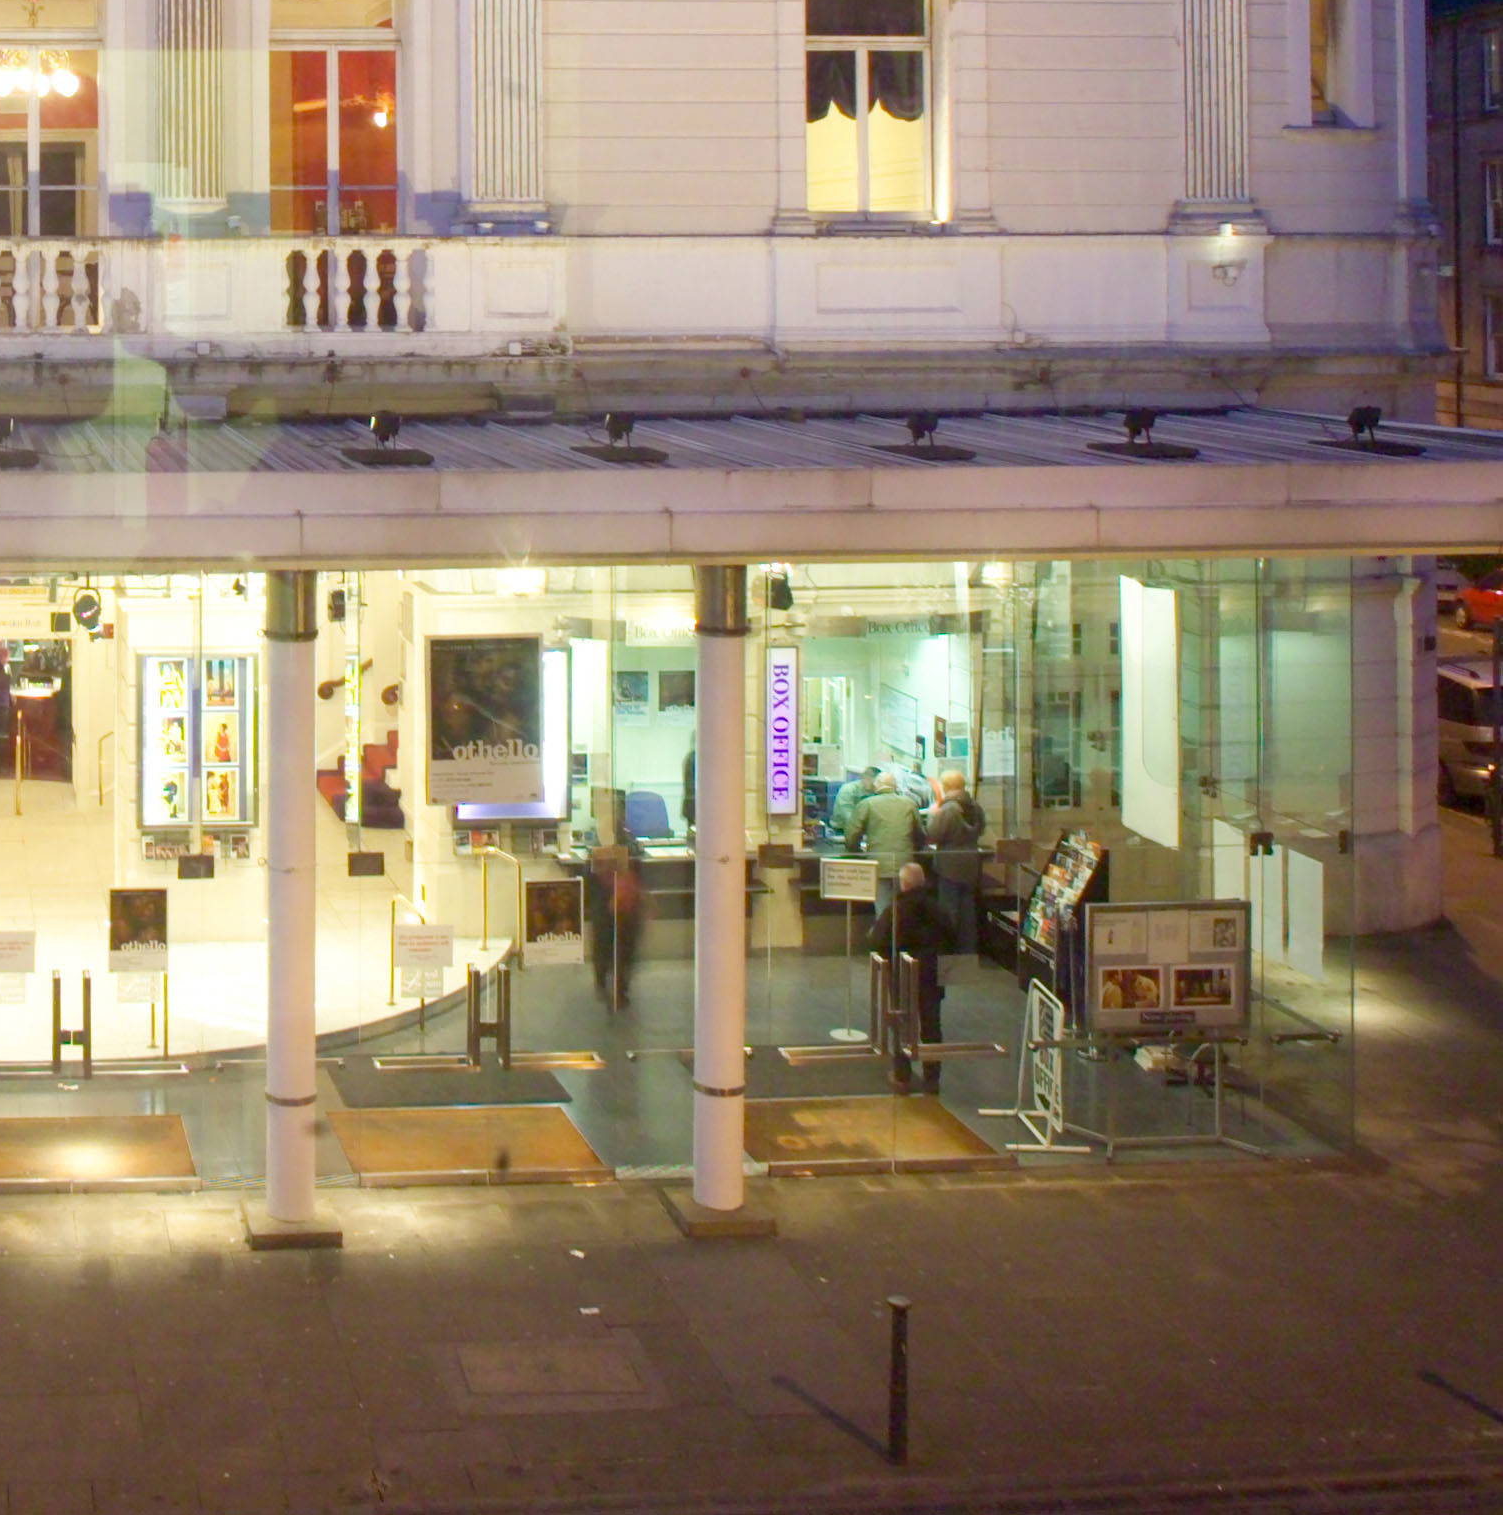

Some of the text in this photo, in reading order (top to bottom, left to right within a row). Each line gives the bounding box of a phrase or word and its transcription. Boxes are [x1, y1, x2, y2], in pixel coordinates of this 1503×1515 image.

[868, 620, 892, 634] Box
[772, 664, 790, 801] BOX OFFICE
[452, 738, 539, 760] othello
[537, 931, 581, 942] othello
[120, 940, 166, 951] othello
